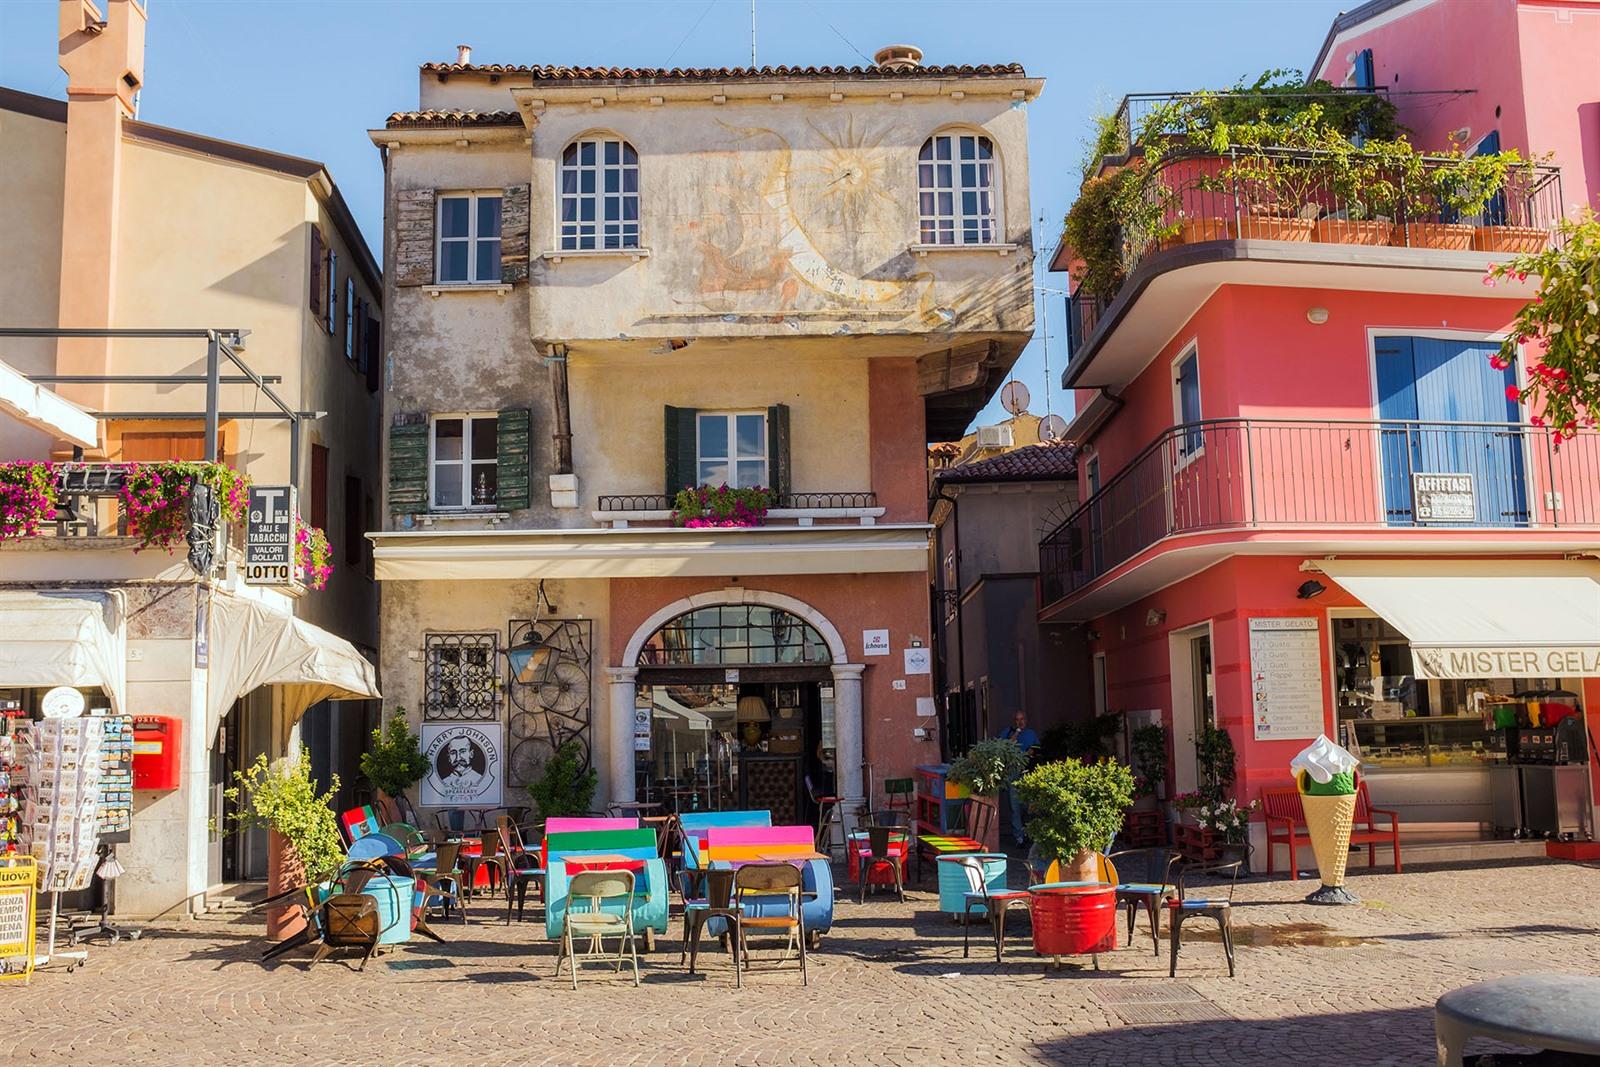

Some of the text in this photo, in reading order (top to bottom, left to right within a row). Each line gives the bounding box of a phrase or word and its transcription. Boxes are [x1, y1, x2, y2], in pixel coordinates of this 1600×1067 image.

[1418, 478, 1471, 492] AFFITTASI
[250, 534, 288, 542] TABACCHI
[246, 566, 288, 578] LOTTO
[1450, 652, 1540, 672] MISTER
[429, 729, 496, 760] HARRY JOHNSON
[0, 872, 30, 882] uova
